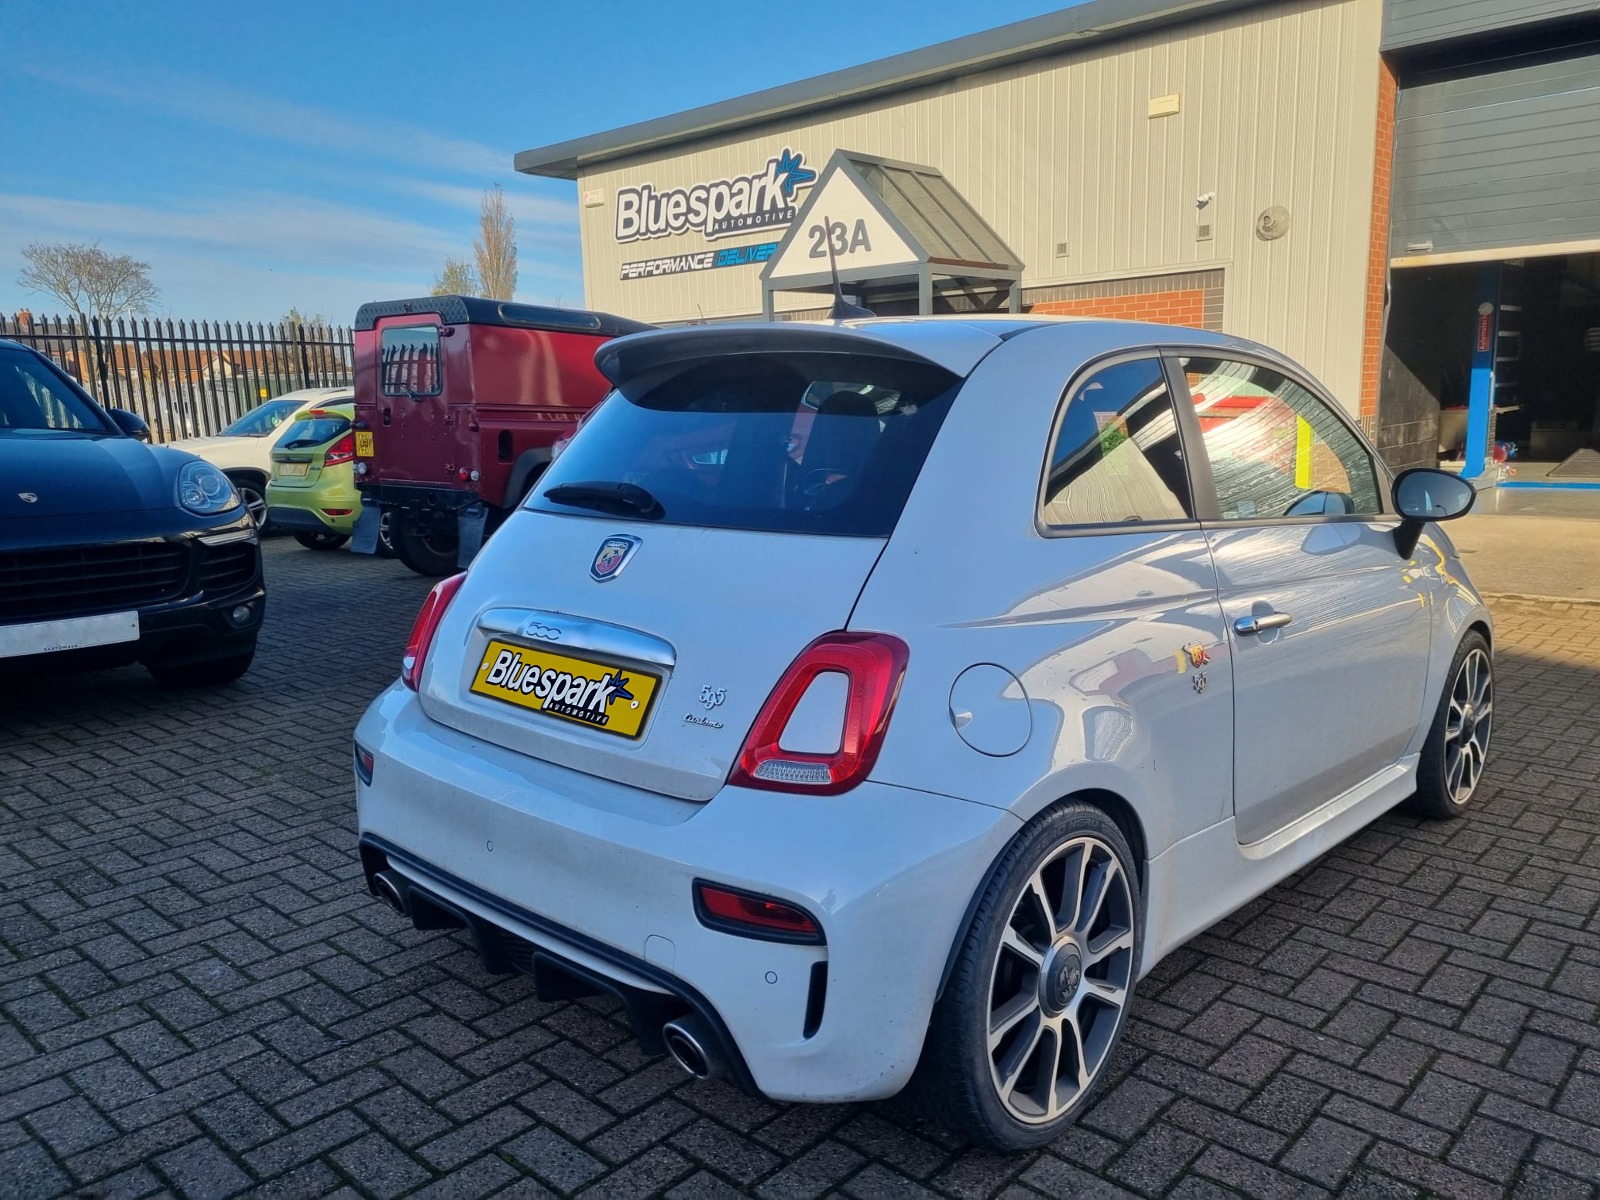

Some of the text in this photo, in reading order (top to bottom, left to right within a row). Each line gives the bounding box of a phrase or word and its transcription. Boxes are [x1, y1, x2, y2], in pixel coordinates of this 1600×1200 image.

[616, 161, 790, 238] Bluespark
[713, 209, 793, 231] AUTOMOTIVE
[808, 218, 872, 259] 23A
[620, 251, 715, 279] PERFORMANCE
[526, 621, 562, 641] 500
[487, 649, 616, 713] Bluespark
[699, 684, 727, 710] 595
[548, 702, 609, 724] AUTOMOTIVE
